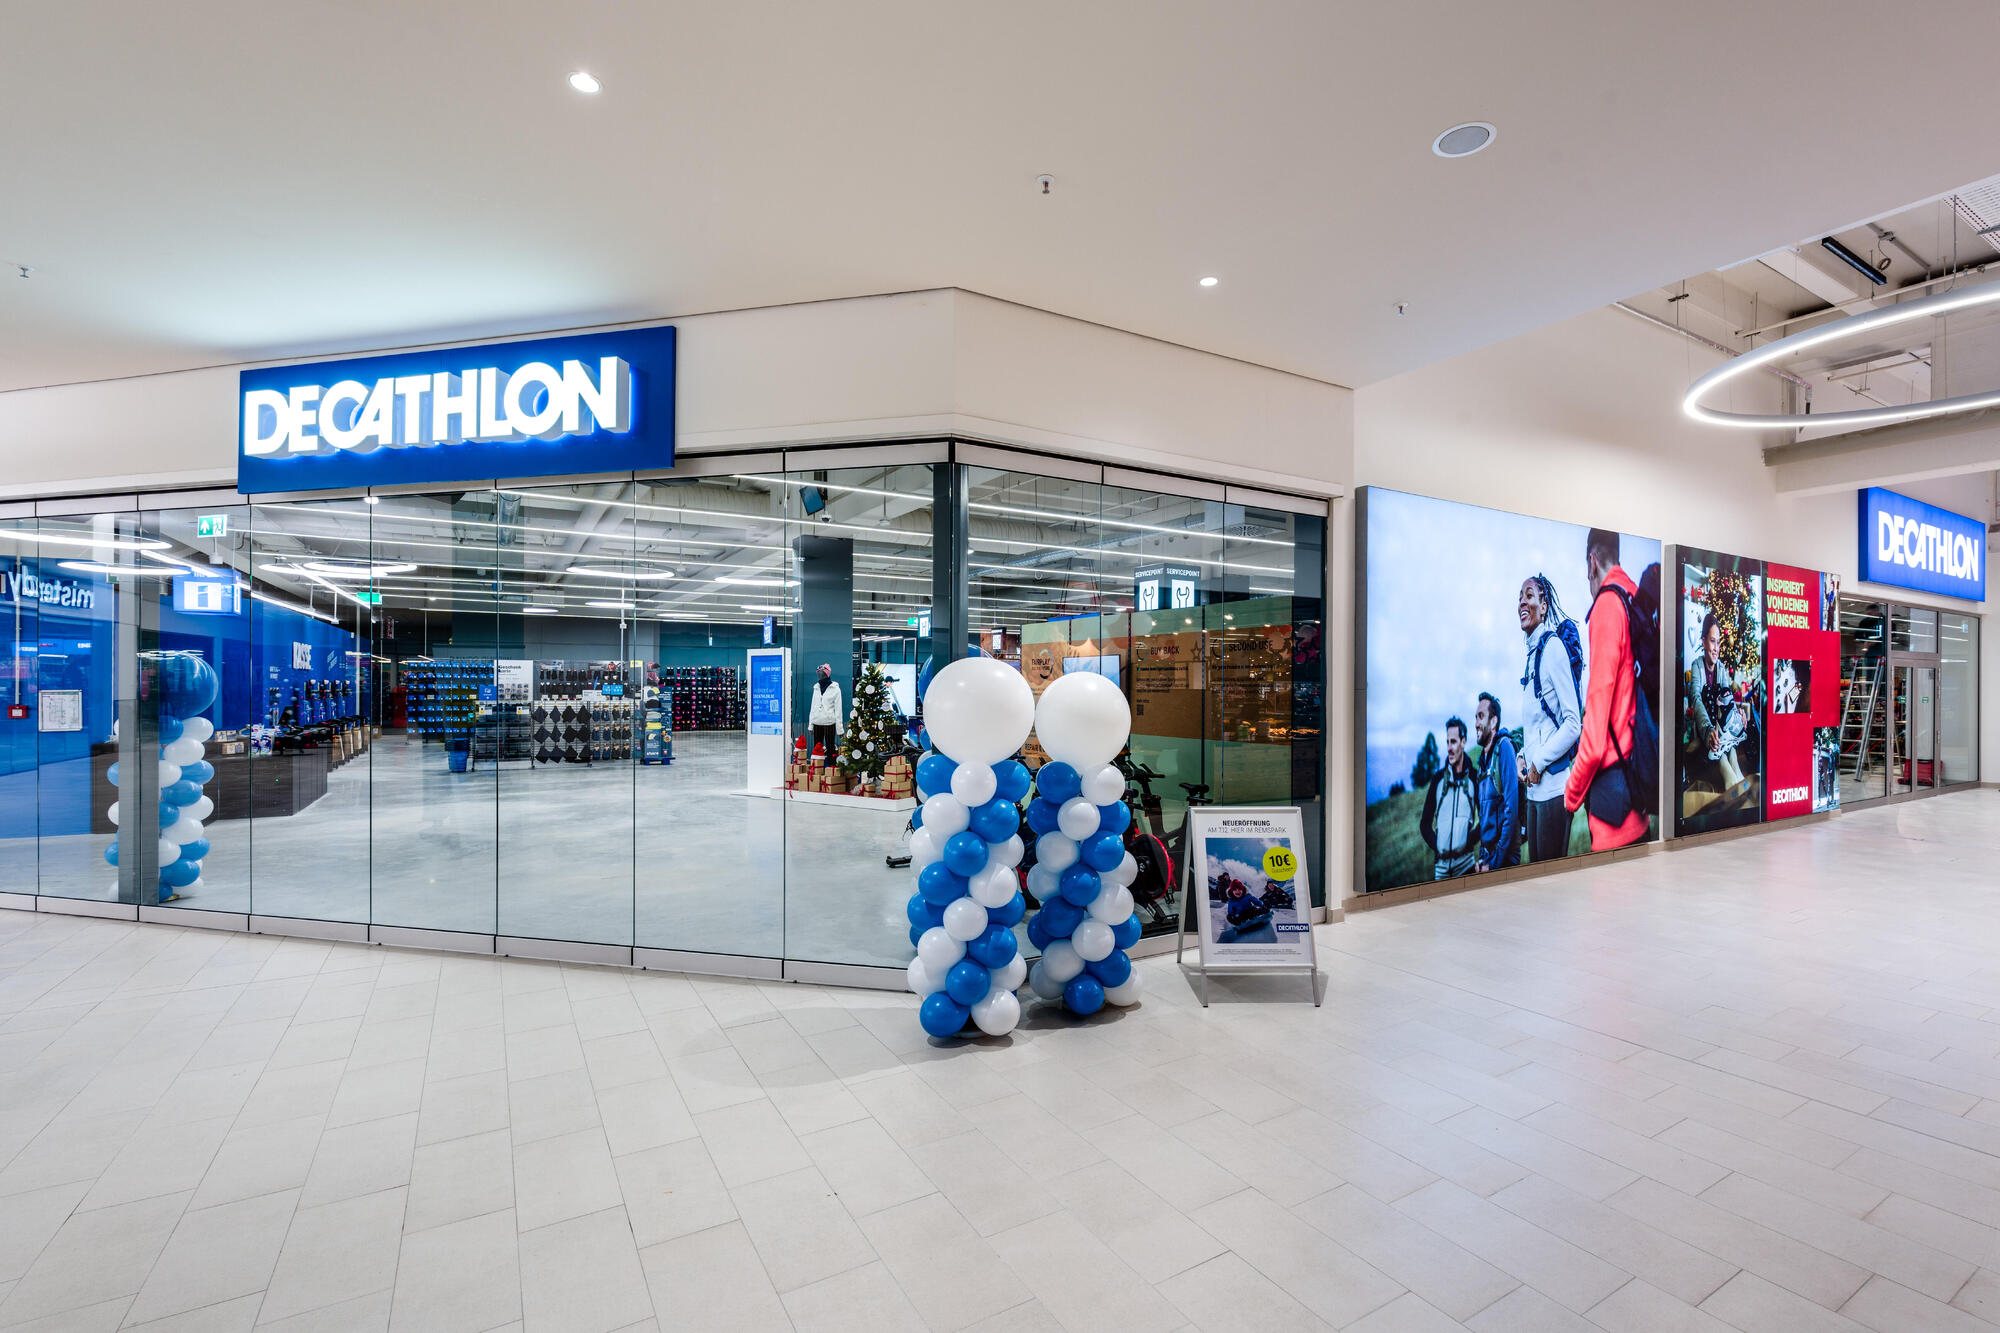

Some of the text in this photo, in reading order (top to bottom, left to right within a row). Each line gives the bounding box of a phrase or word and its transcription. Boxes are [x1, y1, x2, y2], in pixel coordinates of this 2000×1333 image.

[244, 356, 626, 457] DECATHLON
[1878, 510, 1979, 581] DECATHLON
[1135, 568, 1163, 578] SERVICEPOINT
[1166, 568, 1200, 577] SERVICEPOINT
[1766, 577, 1805, 596] INSPIRIERT
[1766, 594, 1809, 613] VON DEINEN
[1766, 609, 1810, 630] WÜNSCHEN.
[1150, 645, 1180, 655] BUY BACK
[1228, 640, 1272, 651] SECOND USE
[1772, 786, 1808, 804] DECATHLON
[1269, 854, 1291, 867] 10€
